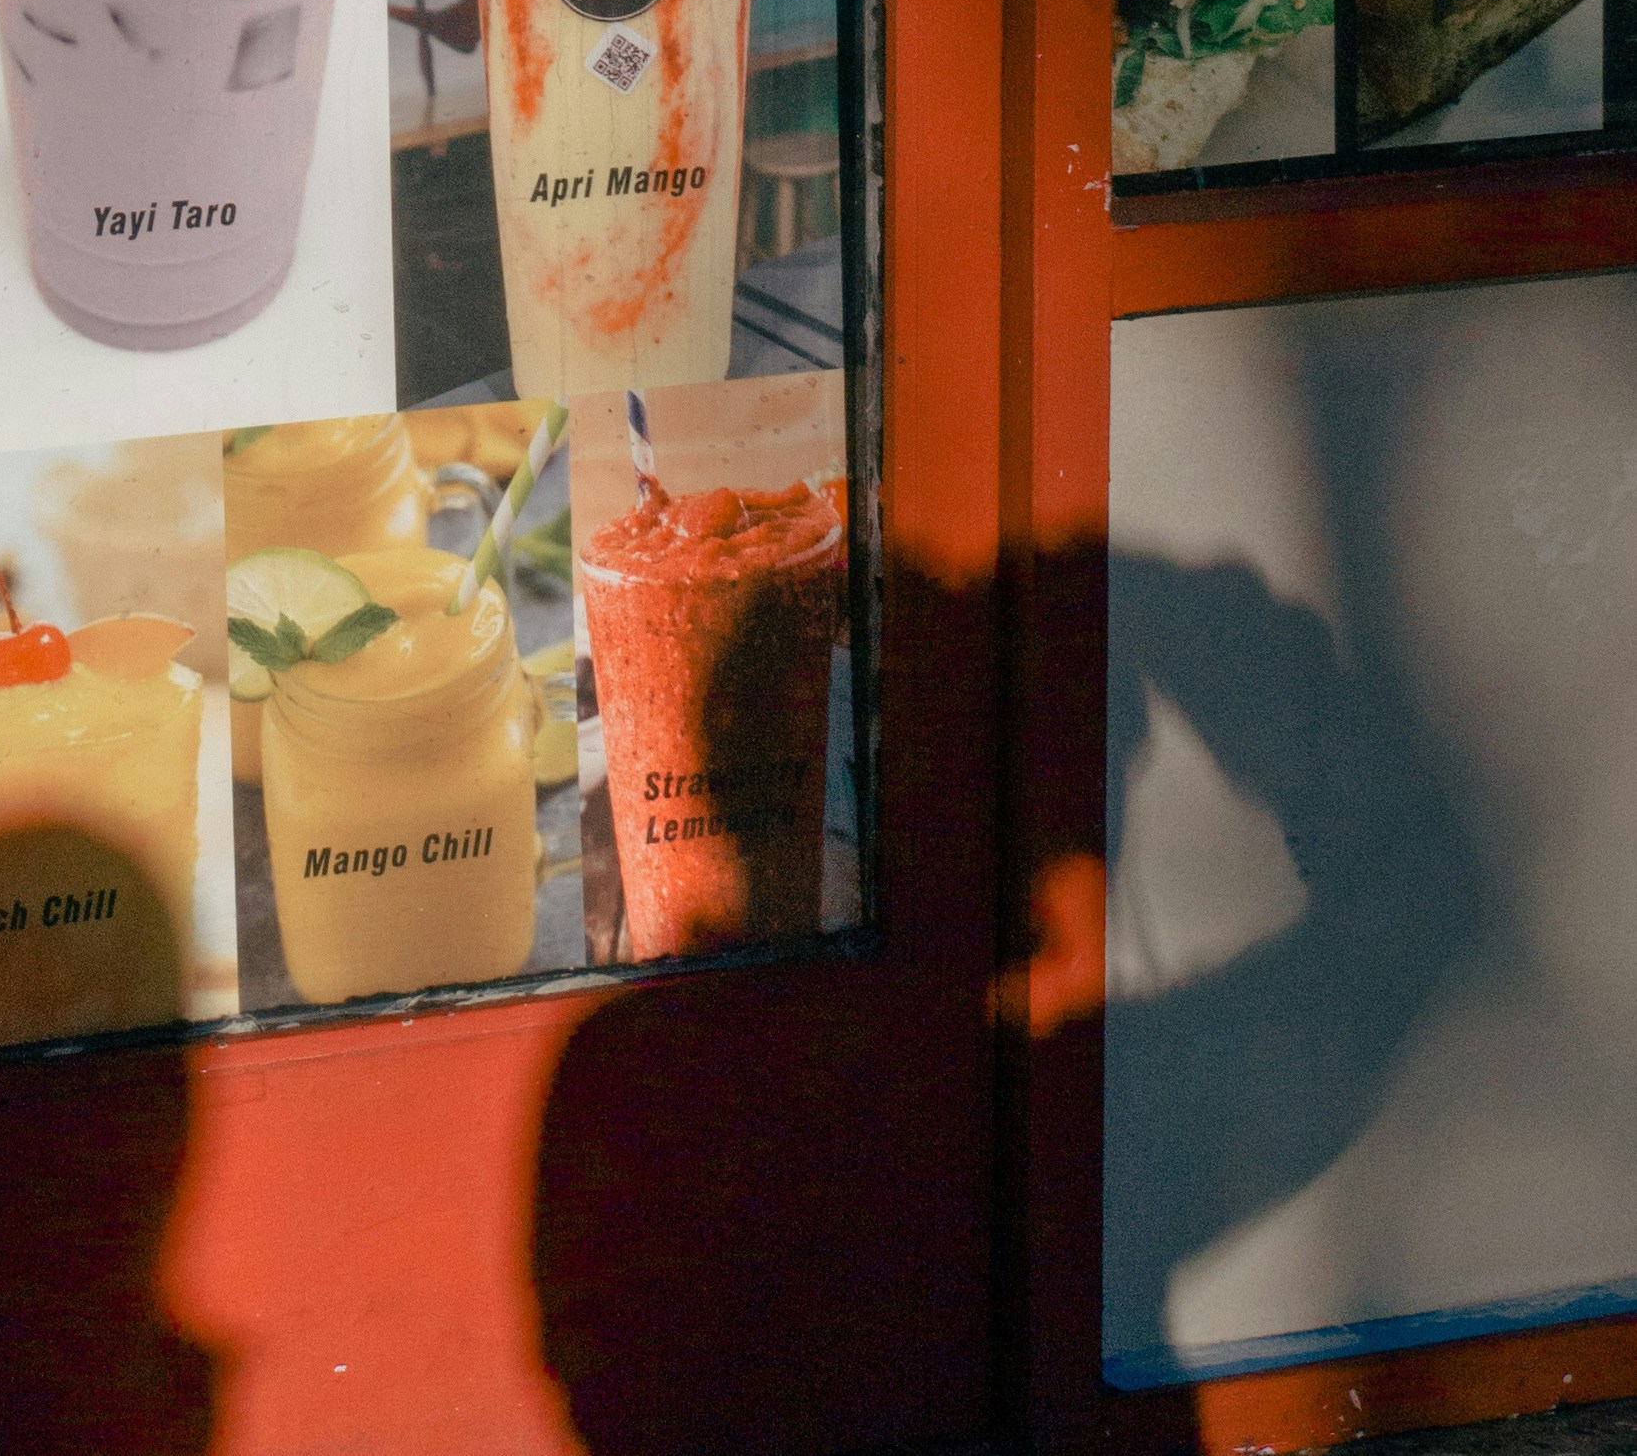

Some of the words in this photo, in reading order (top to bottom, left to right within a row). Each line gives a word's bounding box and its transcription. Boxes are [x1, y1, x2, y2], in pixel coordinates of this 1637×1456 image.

[529, 169, 595, 208] Apri
[605, 165, 707, 198] Mango
[93, 201, 158, 241] Yayi
[170, 199, 238, 231] Taro
[303, 838, 408, 878] Mango
[421, 826, 494, 865] Chill
[42, 888, 118, 929] Chill
